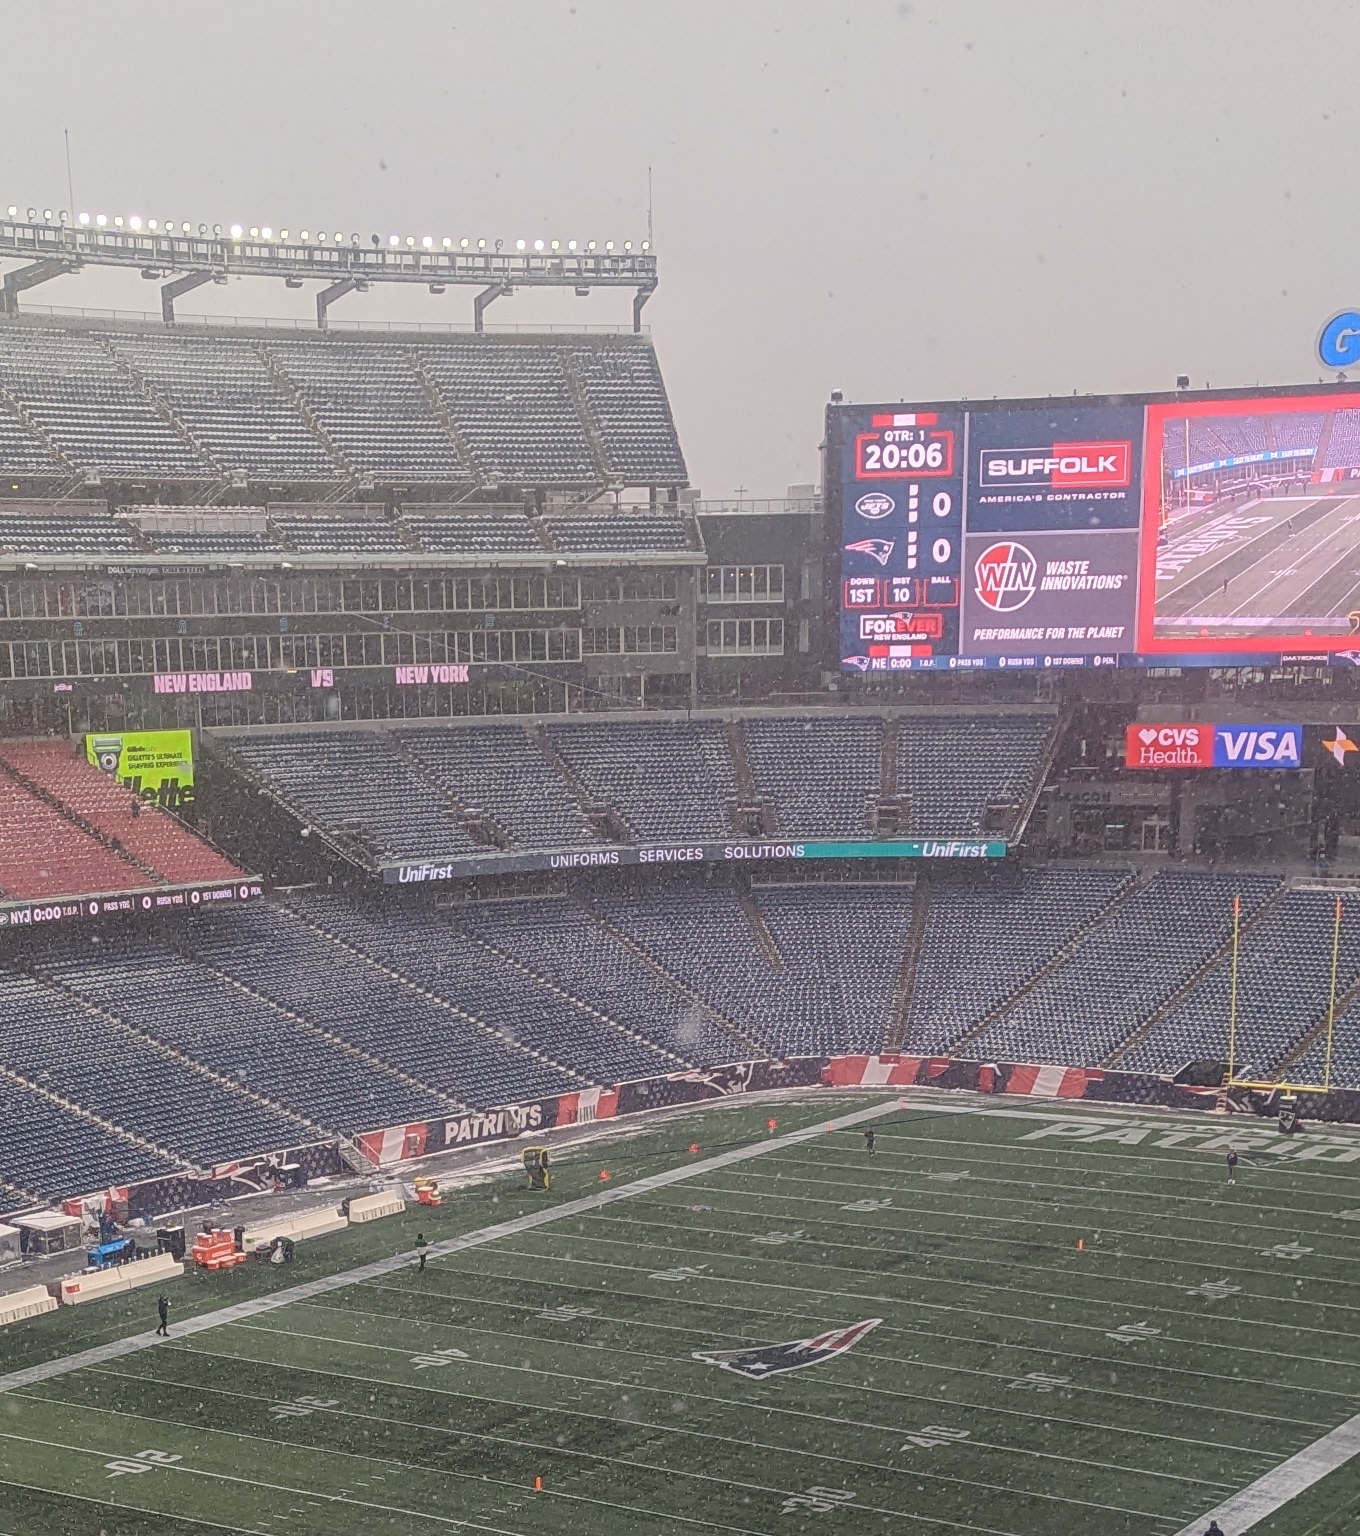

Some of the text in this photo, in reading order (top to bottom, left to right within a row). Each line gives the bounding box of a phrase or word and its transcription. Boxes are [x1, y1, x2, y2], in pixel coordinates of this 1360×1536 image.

[884, 430, 914, 442] QTR:
[865, 443, 943, 470] 20:06
[988, 455, 1118, 477] SUFFOLK
[932, 492, 952, 517] 0
[979, 491, 1126, 504] AMERICA'S CONTRACTOR
[932, 539, 951, 563] 0
[1046, 560, 1090, 576] WASTE
[850, 577, 875, 586] DOWN
[892, 576, 911, 585] DIST
[931, 576, 952, 584] BALL
[1040, 574, 1123, 591] INNOVATIONS
[849, 588, 875, 603] 1ST
[893, 588, 910, 602] 10
[891, 632, 928, 641] ENGLAND
[973, 626, 1126, 641] PERFORMANCE FOR THE PLANET
[872, 657, 912, 669] NE 0:00
[153, 672, 253, 694] NEW ENGLAND
[396, 664, 470, 685] NEW YORK
[1158, 728, 1199, 746] CVS
[1217, 731, 1298, 761] VISA
[550, 844, 806, 868] UNIFORMS SERVICES SOLUTIONS
[922, 840, 989, 858] UniFirst
[398, 863, 454, 883] UniFirst
[10, 906, 62, 925] NYJ 0:00
[909, 1424, 971, 1449] 40
[103, 1448, 184, 1475] 20
[782, 1485, 857, 1513] 30
